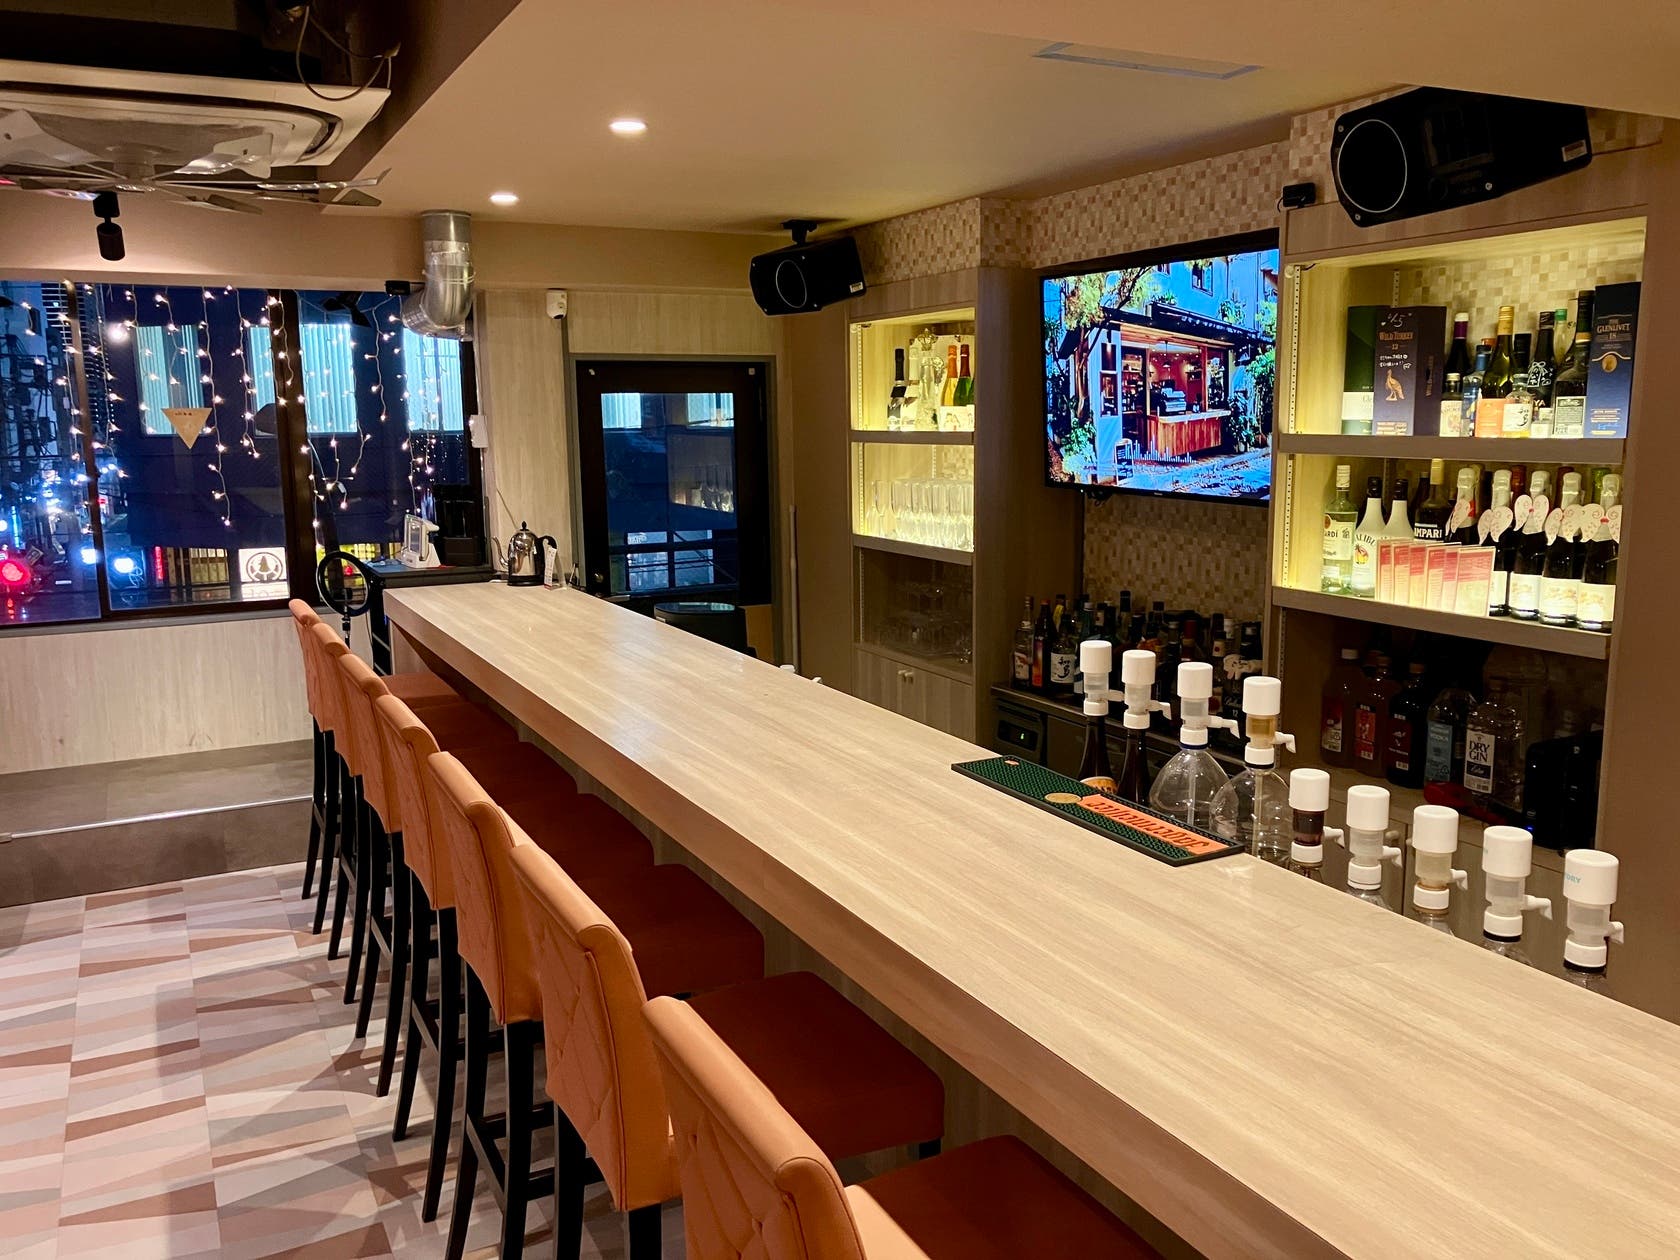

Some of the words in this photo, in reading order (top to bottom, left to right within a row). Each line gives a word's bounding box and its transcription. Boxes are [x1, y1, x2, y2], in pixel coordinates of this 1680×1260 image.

[1596, 323, 1631, 334] GLENLIVET
[1379, 331, 1393, 341] WILD
[1393, 331, 1414, 340] TURKEY
[1414, 527, 1443, 539] MPARI
[1469, 740, 1490, 753] DRY
[1469, 748, 1488, 762] GIN
